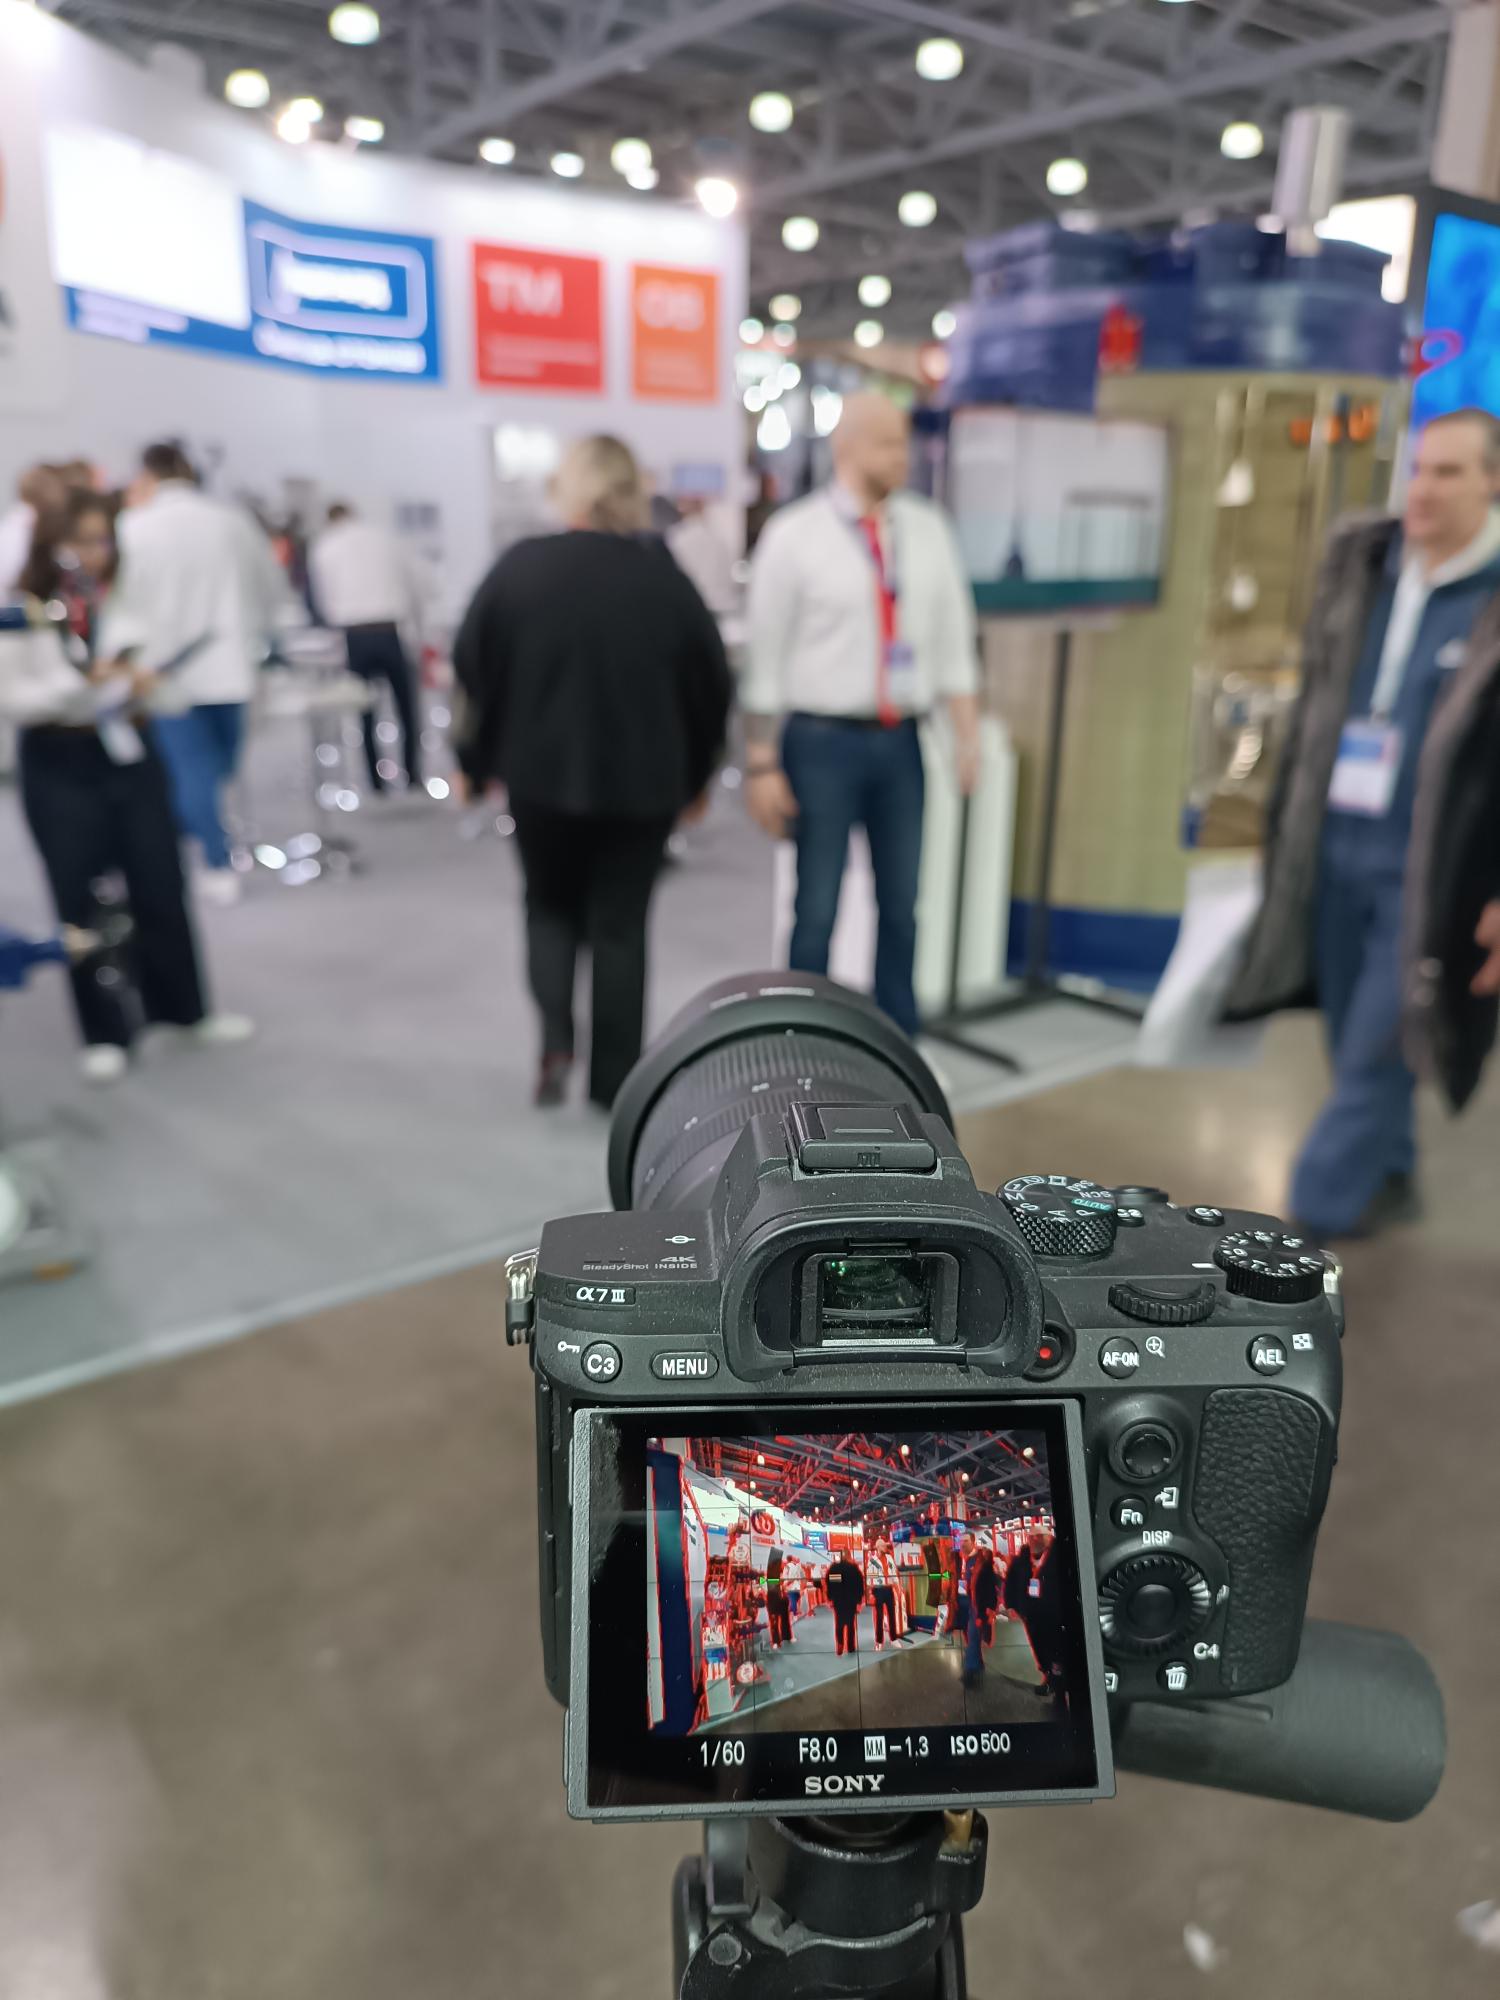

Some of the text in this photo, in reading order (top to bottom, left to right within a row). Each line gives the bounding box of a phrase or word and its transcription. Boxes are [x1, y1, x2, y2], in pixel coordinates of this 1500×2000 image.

[1004, 1192, 1025, 1201] M
[1079, 1190, 1112, 1199] SCN
[1074, 1198, 1112, 1211] AUTO
[1047, 1209, 1066, 1217] A
[1075, 1208, 1096, 1217] P
[583, 1263, 649, 1271] SteadyShot
[586, 1355, 616, 1374] C3
[1255, 1349, 1286, 1366] AEL
[662, 1358, 708, 1376] MENU
[1120, 1509, 1143, 1525] Fn
[1142, 1531, 1171, 1546] DISP
[1193, 1642, 1219, 1659] C4
[700, 1739, 746, 1767] 1/60
[799, 1735, 838, 1763] F8.0
[950, 1735, 979, 1756] ISO
[981, 1732, 1011, 1754] 500
[804, 1773, 886, 1795] SONY
